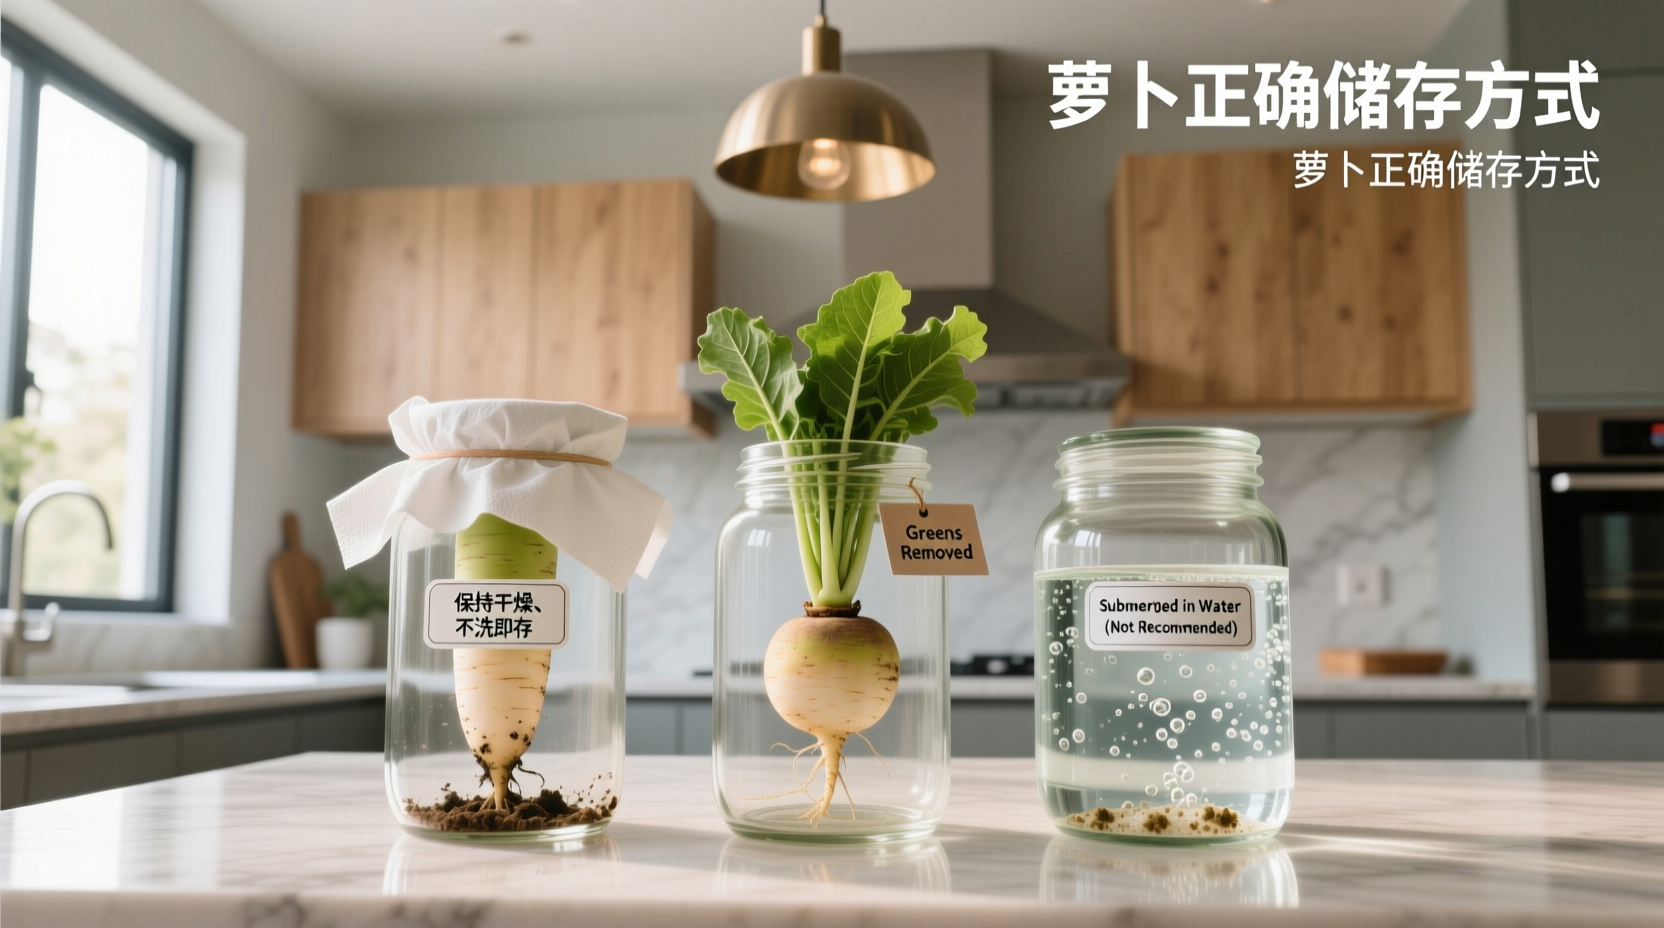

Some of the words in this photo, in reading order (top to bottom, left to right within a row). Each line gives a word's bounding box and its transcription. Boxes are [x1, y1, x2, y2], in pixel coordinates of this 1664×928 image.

[906, 525, 963, 541] Greens
[901, 543, 974, 560] Removed
[1182, 599, 1196, 613] in
[1199, 599, 1241, 613] Water
[456, 616, 533, 639] 不洗即存
[1105, 619, 1135, 636] (Not
